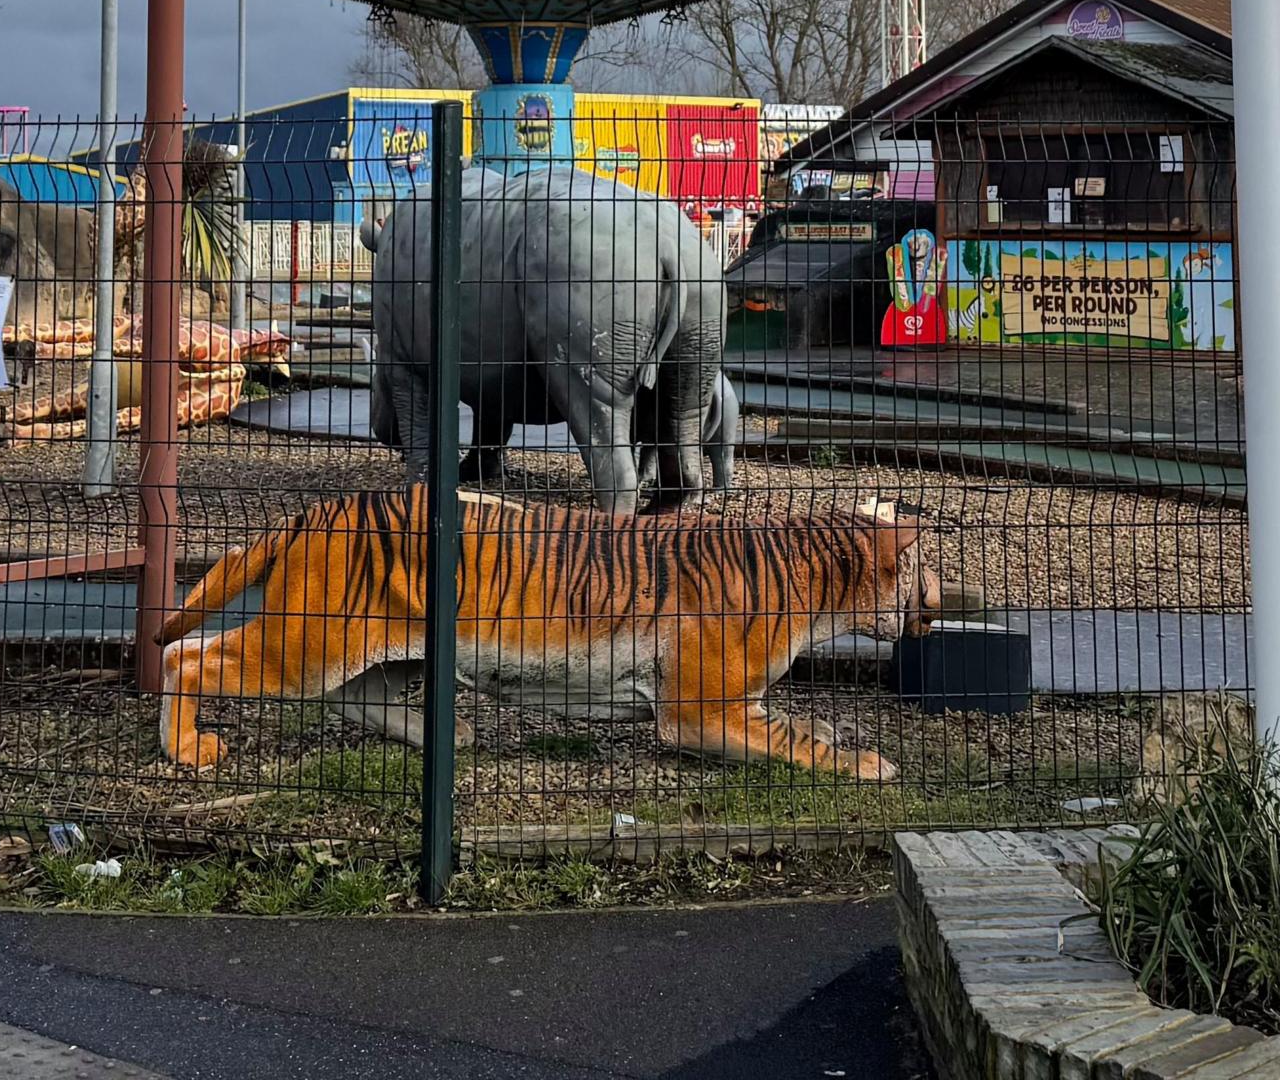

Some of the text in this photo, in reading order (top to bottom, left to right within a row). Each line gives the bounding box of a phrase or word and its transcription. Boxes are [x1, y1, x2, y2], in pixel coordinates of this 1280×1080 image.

[1040, 276, 1073, 294] PER
[1033, 295, 1138, 316] PER ROUND
